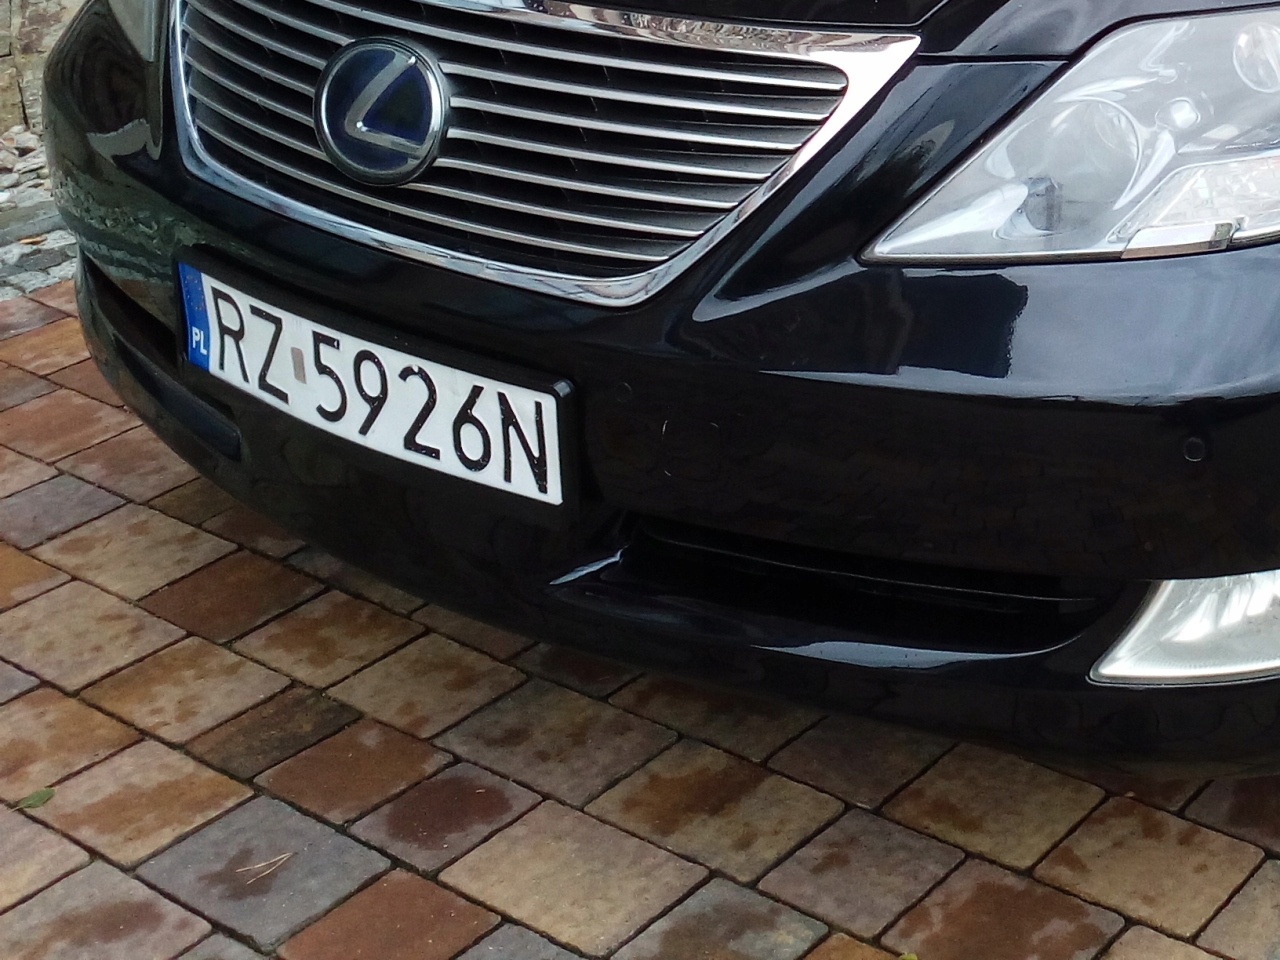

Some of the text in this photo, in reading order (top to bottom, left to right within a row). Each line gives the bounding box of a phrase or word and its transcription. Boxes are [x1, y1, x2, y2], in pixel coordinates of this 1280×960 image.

[192, 326, 207, 355] PL
[211, 286, 548, 494] RZ 5926N
